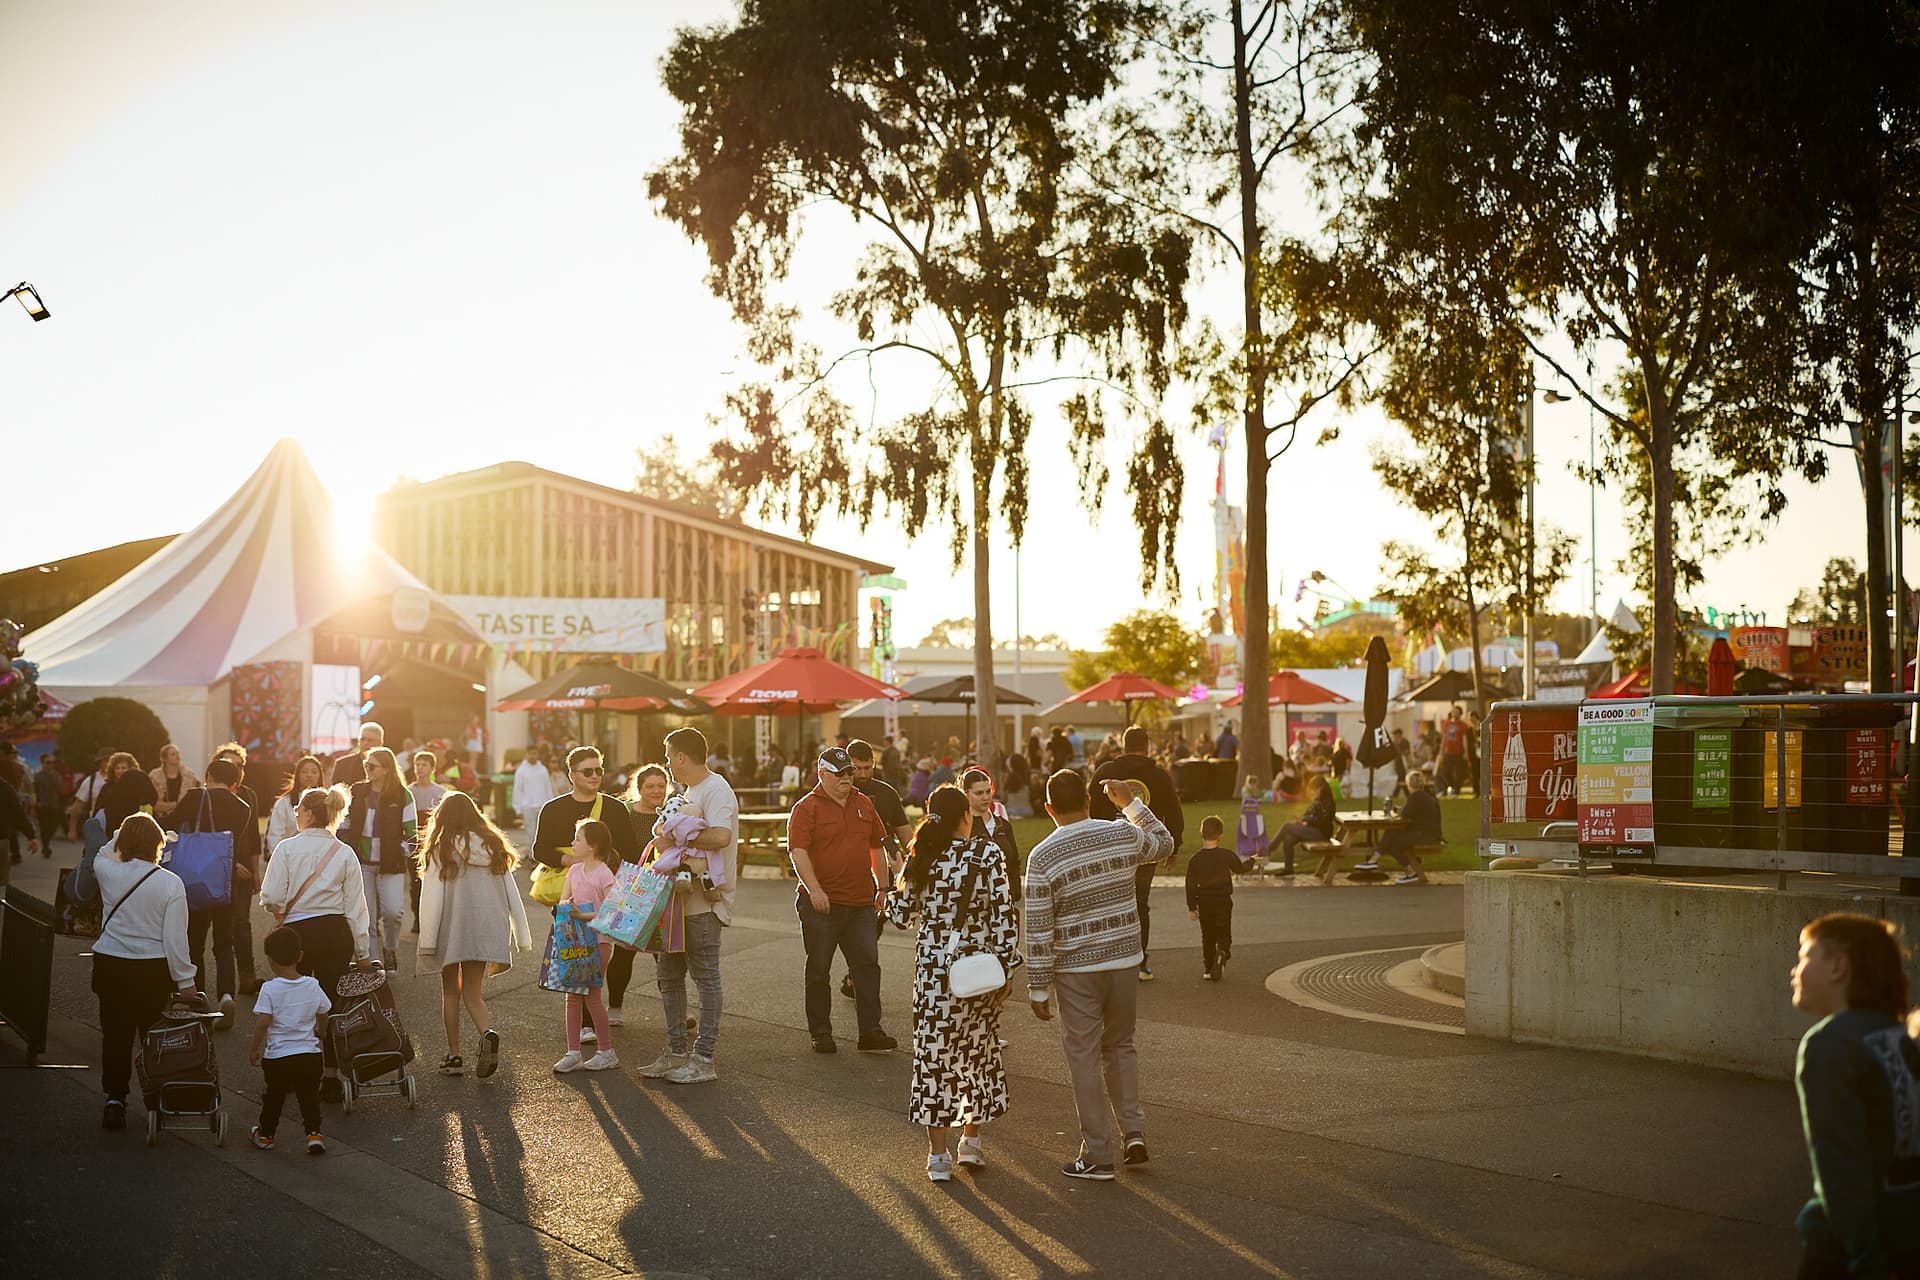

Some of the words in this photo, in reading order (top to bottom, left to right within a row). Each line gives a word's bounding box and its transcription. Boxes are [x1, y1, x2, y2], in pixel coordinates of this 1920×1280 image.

[477, 613, 555, 635] TASTE
[563, 615, 595, 635] SA
[1736, 632, 1783, 648] CHIPS
[749, 689, 798, 699] nova
[1583, 711, 1594, 719] BE
[1594, 711, 1600, 719] A
[1601, 709, 1624, 718] GOOD
[1625, 708, 1649, 718] SORT!
[1620, 726, 1652, 736] GREEN
[1614, 765, 1650, 776] YELLOW
[1633, 776, 1650, 786] BIN
[1075, 1160, 1085, 1171] N
